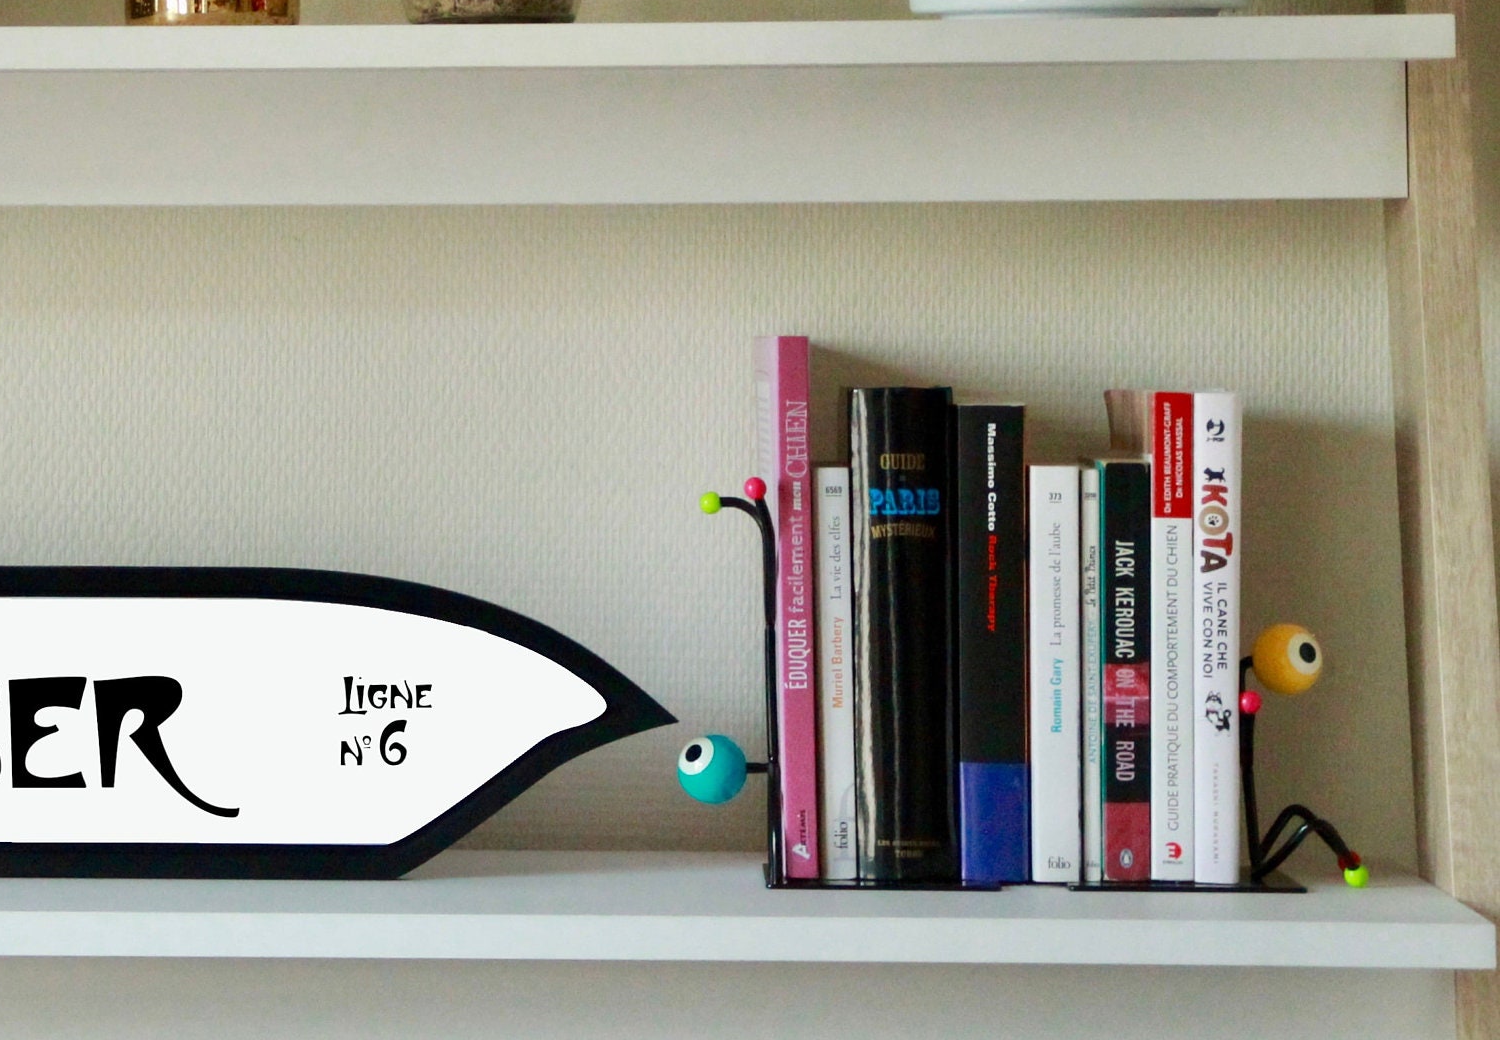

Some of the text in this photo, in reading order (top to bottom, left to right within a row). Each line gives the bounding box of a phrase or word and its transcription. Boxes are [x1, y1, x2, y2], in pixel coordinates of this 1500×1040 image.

[785, 400, 808, 478] CHIEN
[880, 453, 925, 470] GUIDE
[987, 423, 997, 531] Massimo Cotto
[868, 488, 941, 516] PARIS
[1049, 492, 1062, 501] 373
[1199, 484, 1233, 573] KOTA
[788, 515, 805, 613] facilement
[828, 516, 842, 600] La vie des elfes
[987, 535, 998, 632] Rock Therapy
[1049, 522, 1065, 646] La promesse de l'aube
[1115, 540, 1135, 659] JACK KEROUAC
[785, 619, 810, 689] ÉDUQUER
[831, 616, 844, 708] Muriel Barbery
[1203, 582, 1213, 678] VIVE CON NOI
[1217, 582, 1228, 670] IL CANE CHE
[1050, 658, 1064, 733] Romain Gary
[1166, 525, 1181, 831] GUIDE PRATIQUE DU COMPORTEMENT DU CHIEN
[379, 719, 407, 766] 6
[1088, 716, 1097, 763] ANTOINE
[1115, 668, 1135, 782] ON THE ROAD
[834, 821, 849, 849] folio
[1047, 856, 1071, 870] folio
